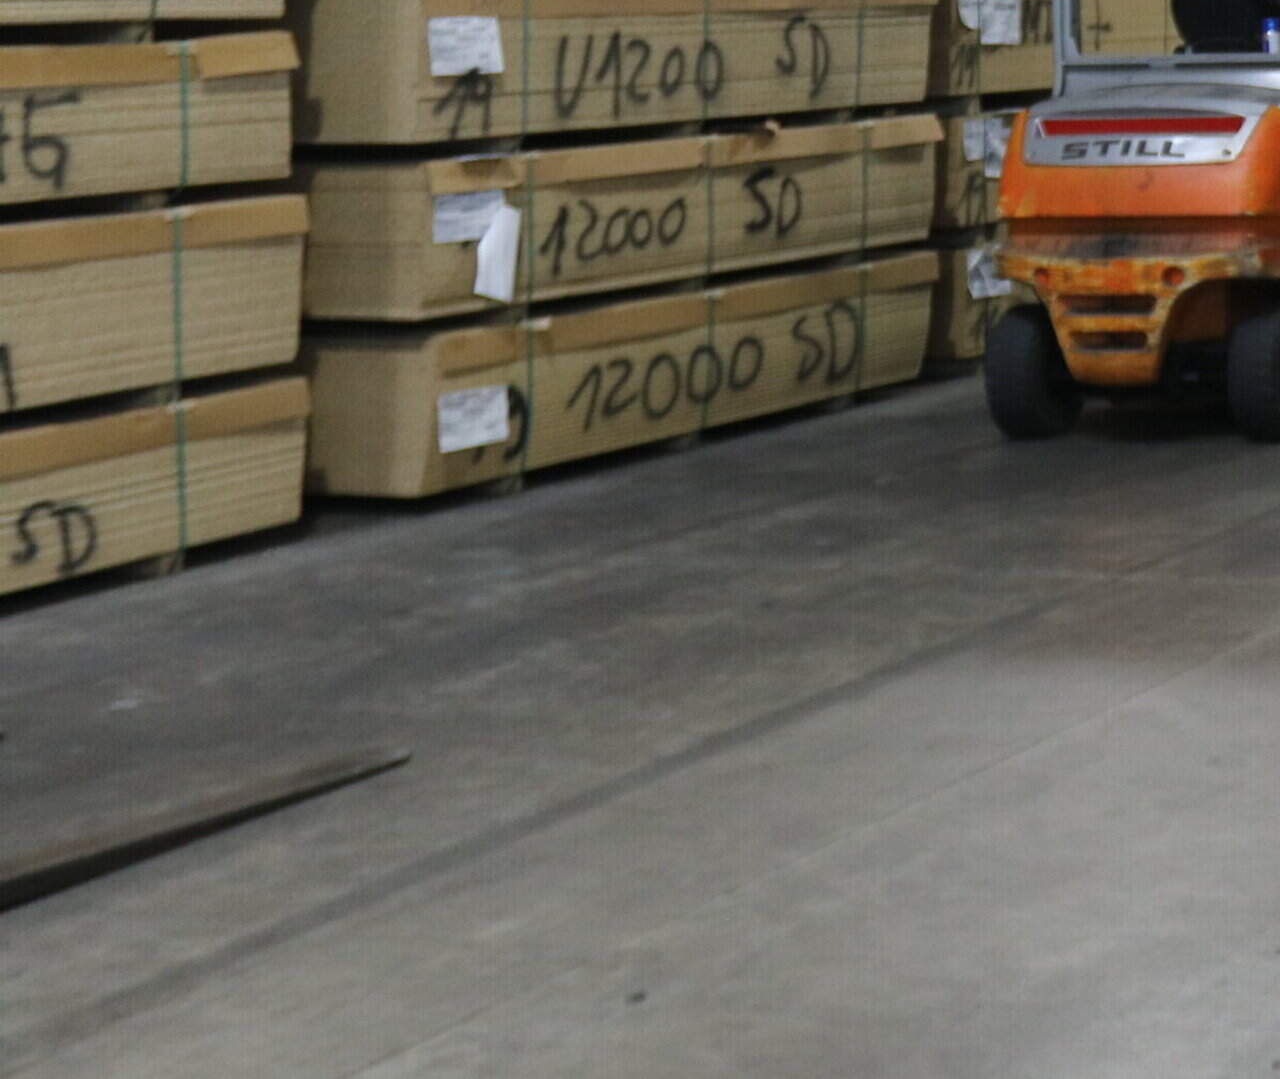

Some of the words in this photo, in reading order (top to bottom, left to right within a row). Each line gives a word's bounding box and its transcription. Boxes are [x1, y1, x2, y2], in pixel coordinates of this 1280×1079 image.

[555, 26, 726, 120] U1200
[774, 13, 832, 102] SD
[1061, 139, 1187, 162] STILL
[539, 195, 688, 279] 12000
[742, 165, 803, 240] SD
[566, 333, 765, 434] 12000
[790, 300, 862, 385] SD
[10, 498, 99, 577] SD
